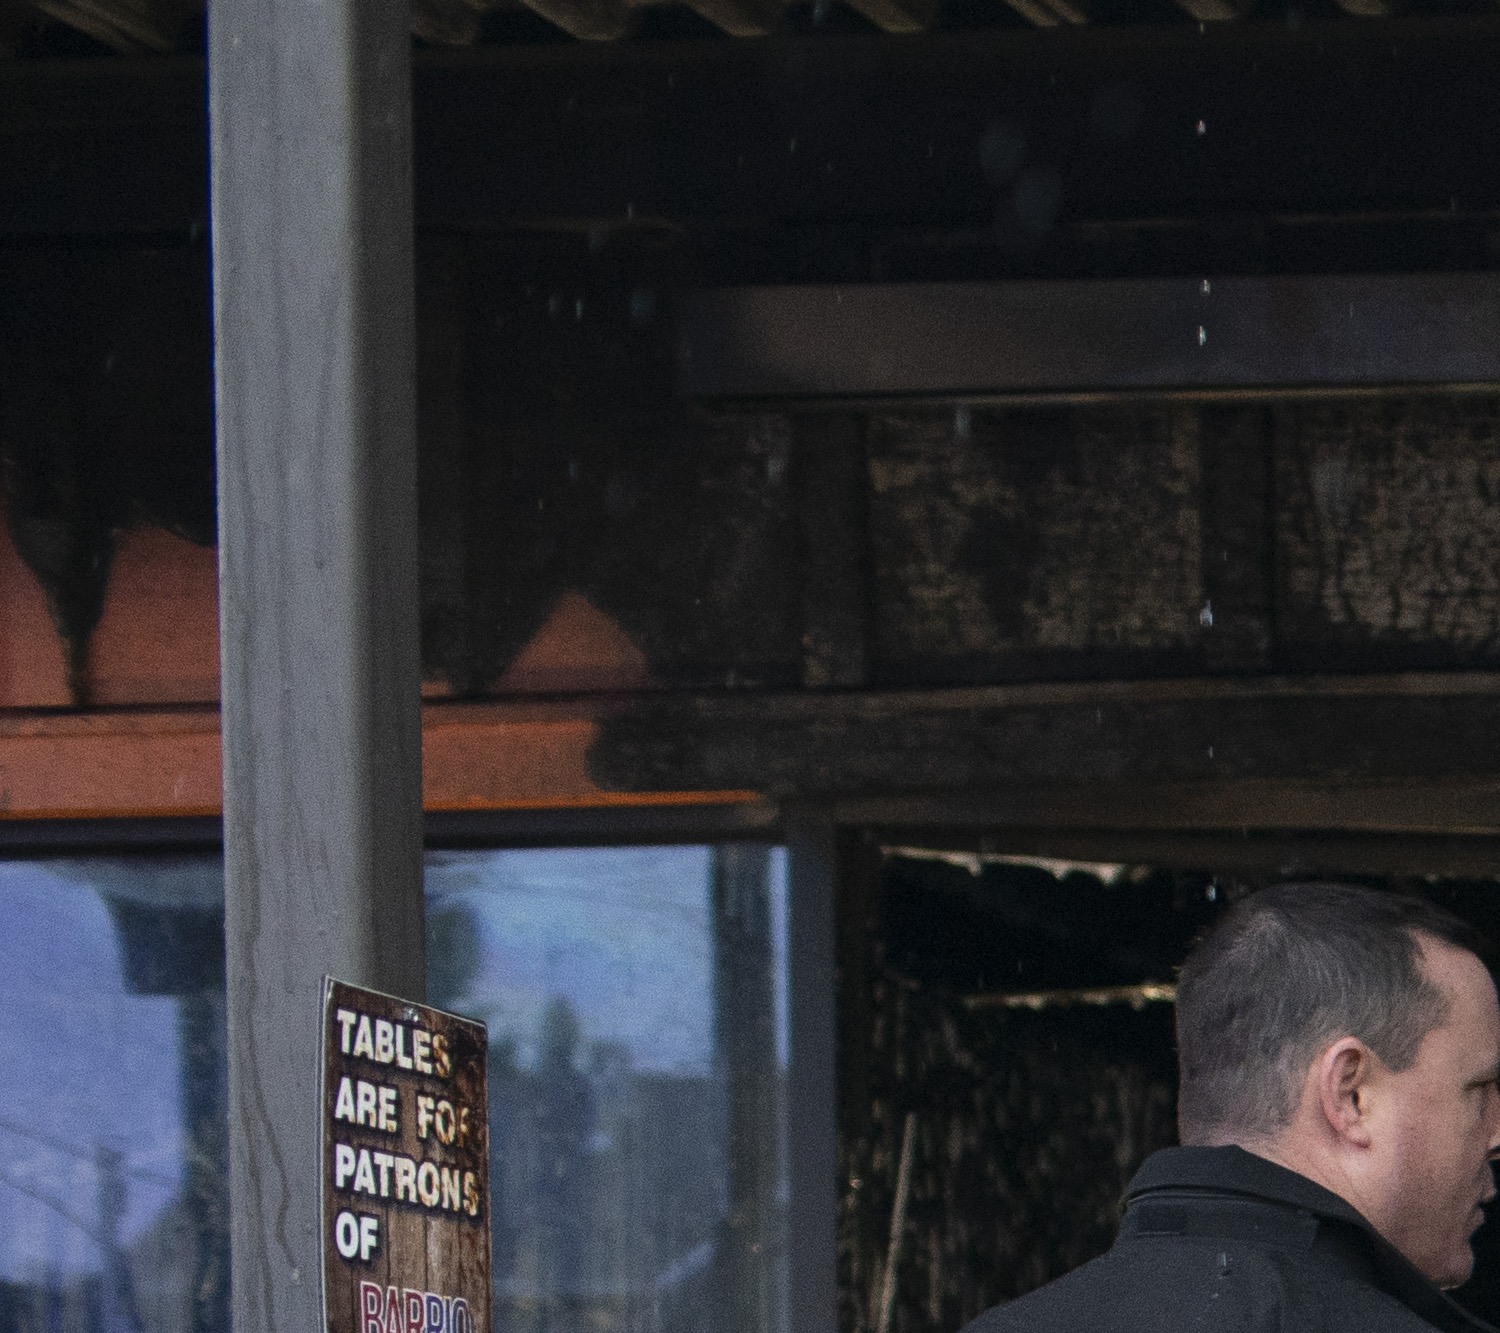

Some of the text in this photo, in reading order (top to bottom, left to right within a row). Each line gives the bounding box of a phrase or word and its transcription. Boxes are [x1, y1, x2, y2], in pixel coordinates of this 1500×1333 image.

[337, 1009, 451, 1078] TABLES
[334, 1078, 398, 1132] ARE
[335, 1144, 479, 1216] PATRONS
[335, 1211, 379, 1261] OF
